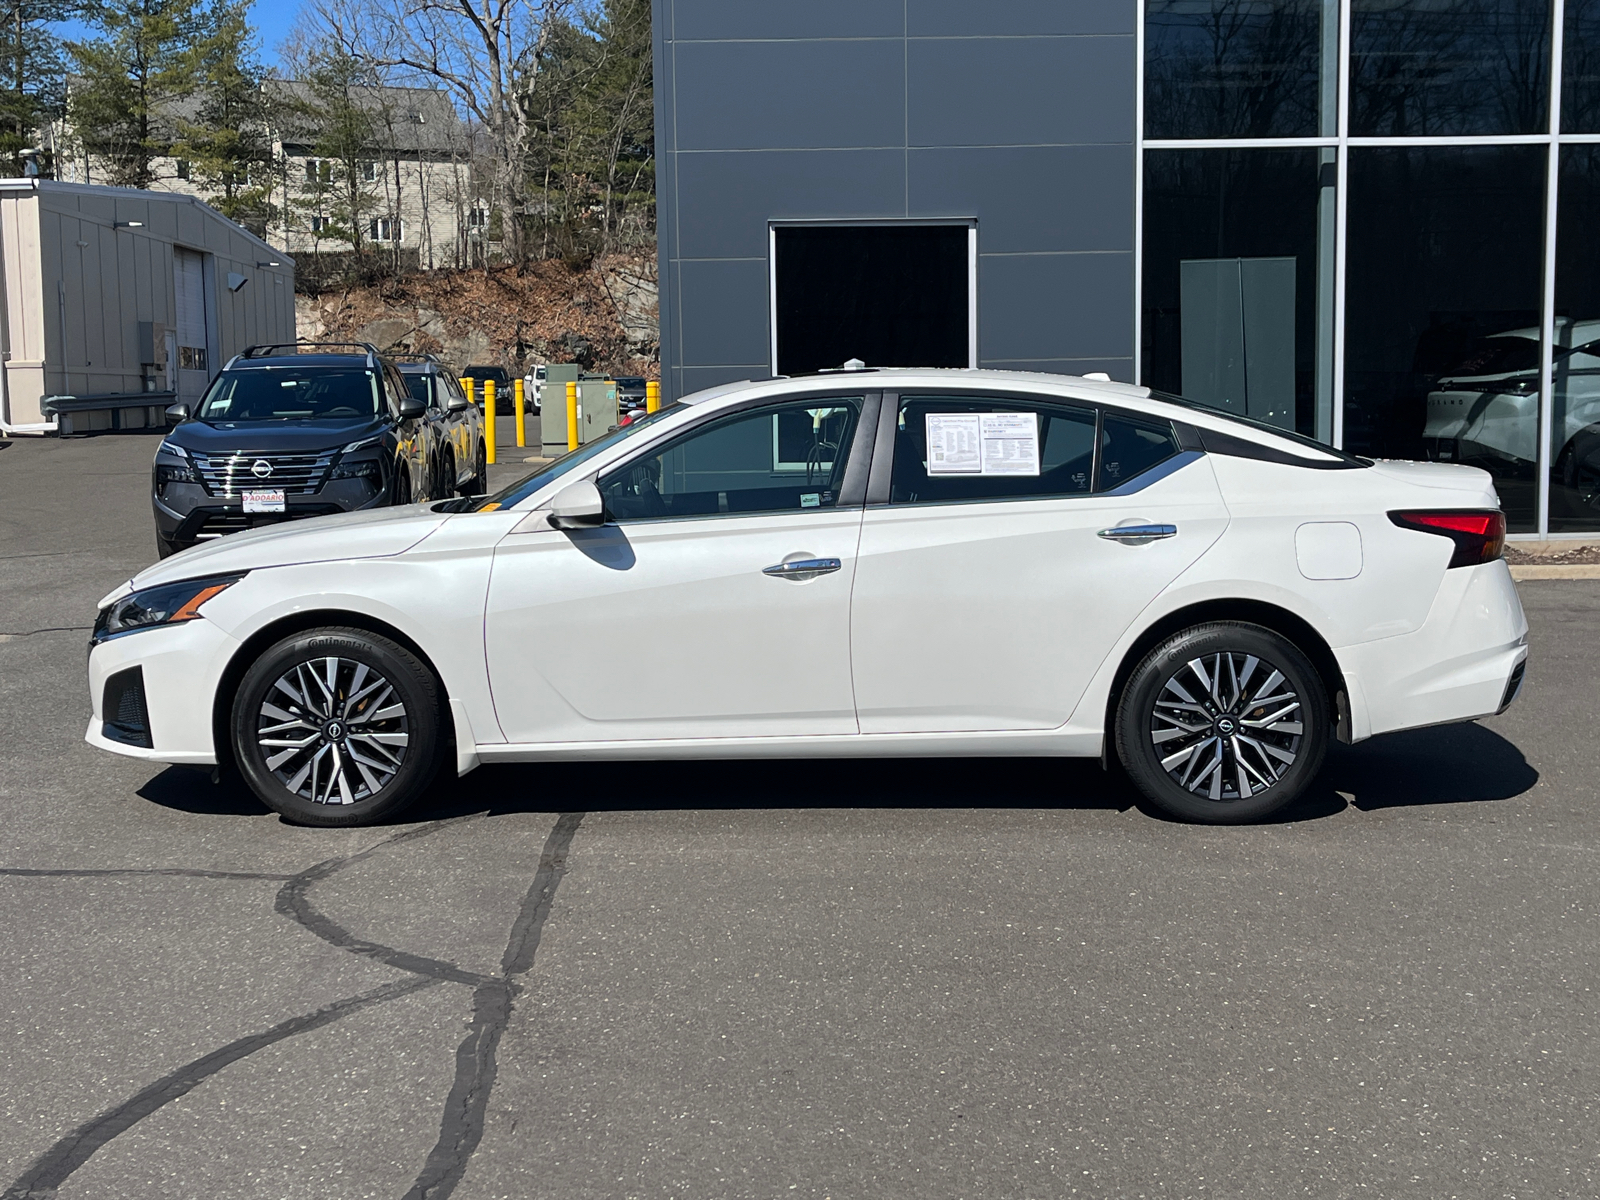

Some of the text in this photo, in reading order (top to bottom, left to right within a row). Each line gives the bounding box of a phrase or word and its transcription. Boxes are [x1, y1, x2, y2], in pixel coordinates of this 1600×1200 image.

[242, 494, 284, 502] D'ADDARIO
[308, 637, 366, 650] Continental
[1168, 633, 1220, 661] Continental
